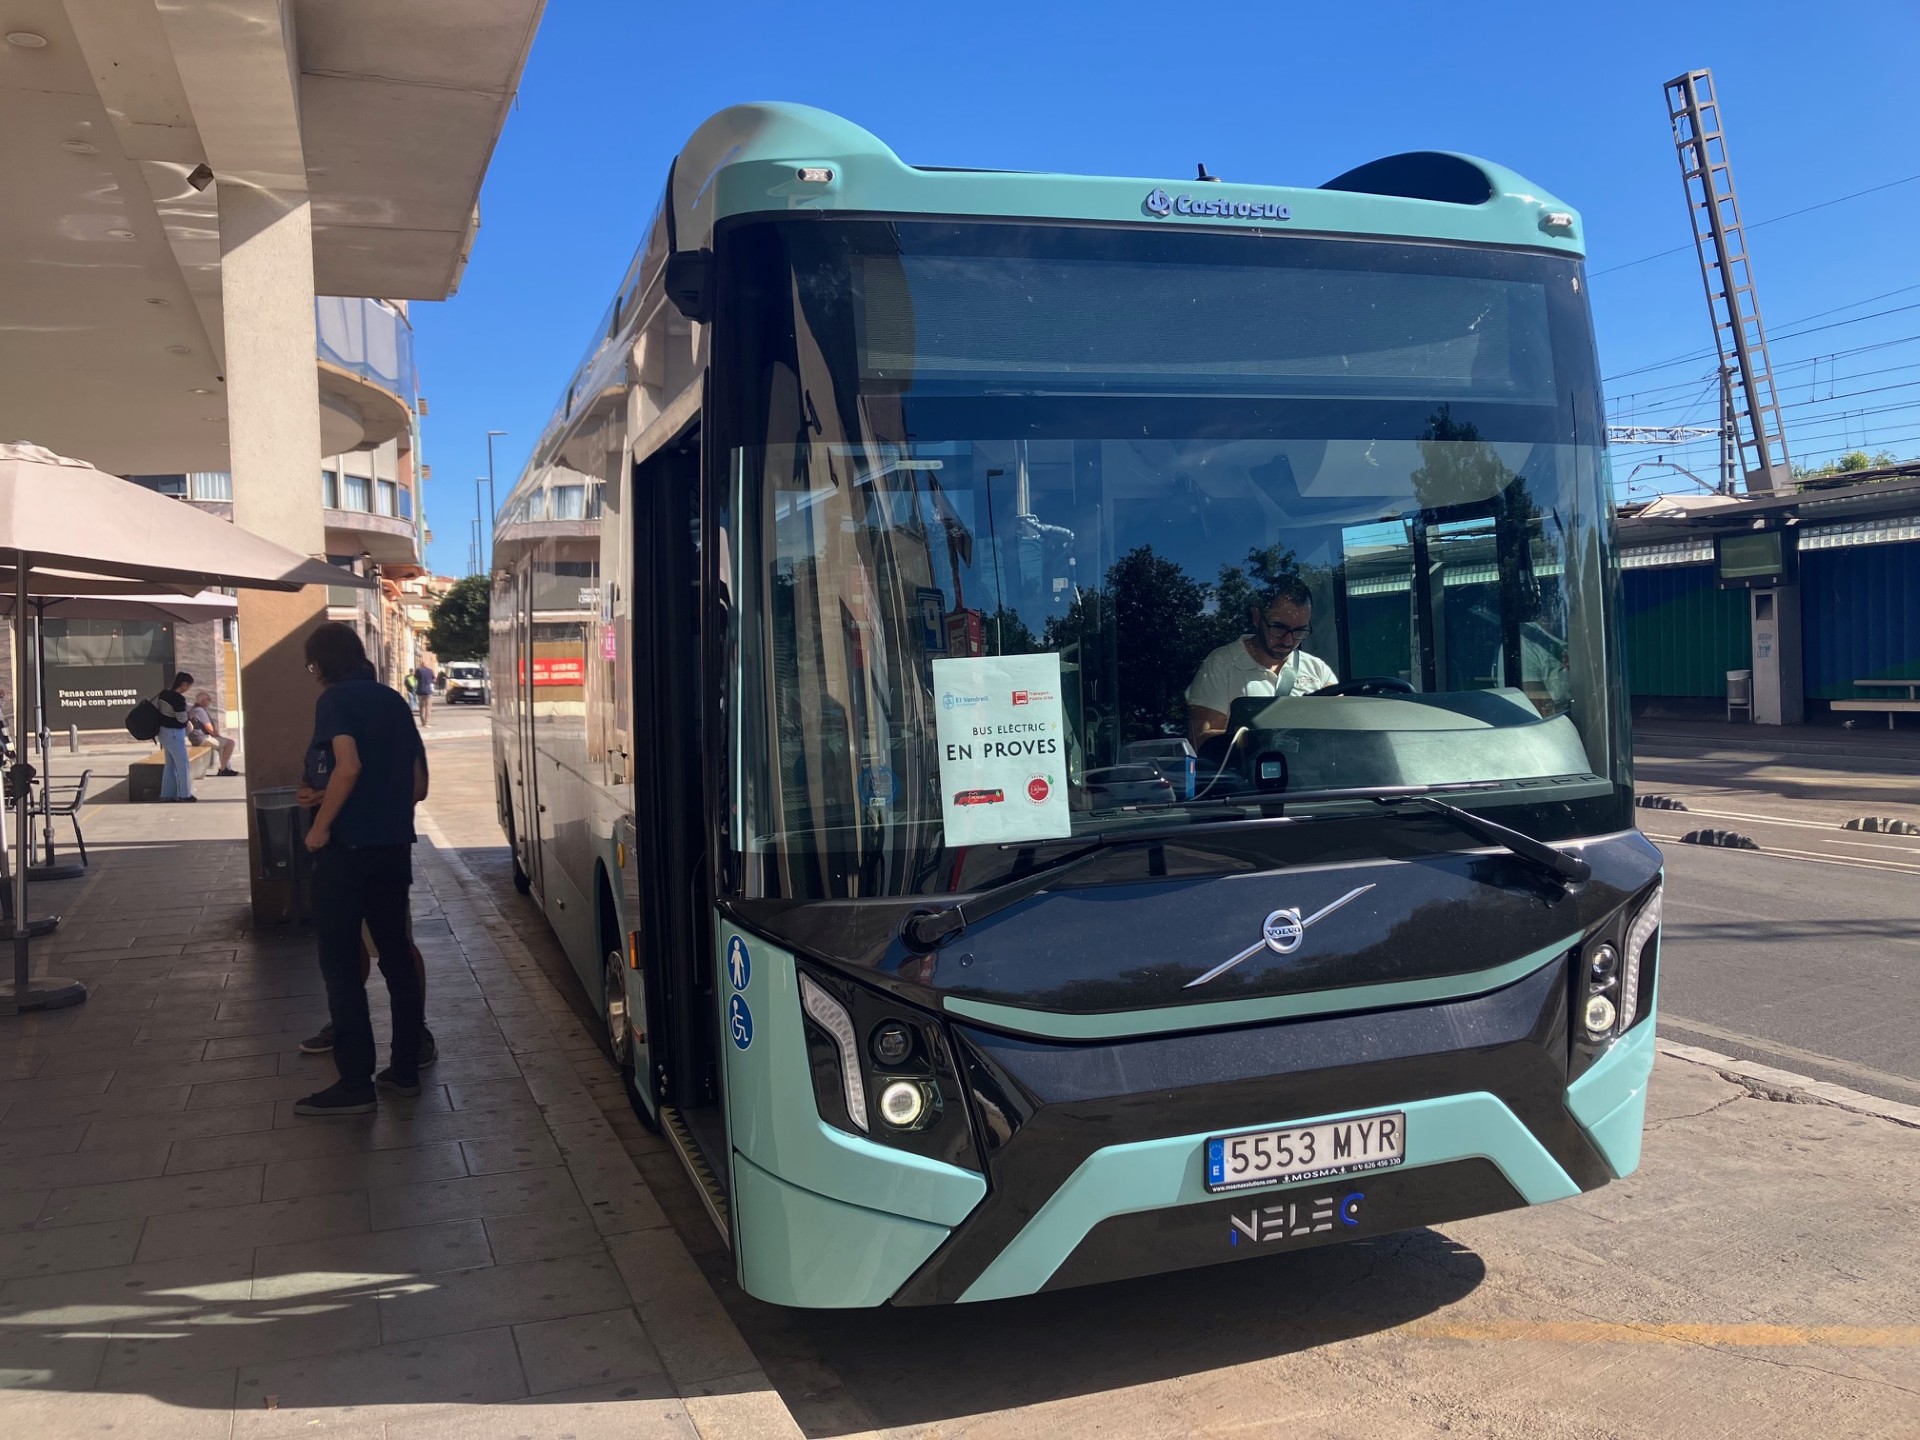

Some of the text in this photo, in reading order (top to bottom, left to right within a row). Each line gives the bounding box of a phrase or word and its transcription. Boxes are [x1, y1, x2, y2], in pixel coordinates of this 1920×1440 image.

[1176, 194, 1292, 220] Castrosua
[59, 690, 84, 698] Pensa
[105, 689, 137, 698] menges
[61, 698, 87, 708] Menja
[107, 698, 136, 707] penses
[972, 726, 992, 736] BUS
[946, 738, 1057, 761] EN PROVES
[1266, 927, 1301, 937] VOLVO
[1231, 1119, 1396, 1174] 5553 MYR
[1212, 1165, 1220, 1176] E
[1212, 1178, 1278, 1192] www.mosmasolutions.com
[1292, 1168, 1338, 1182] MOSMA
[1364, 1161, 1376, 1169] 626
